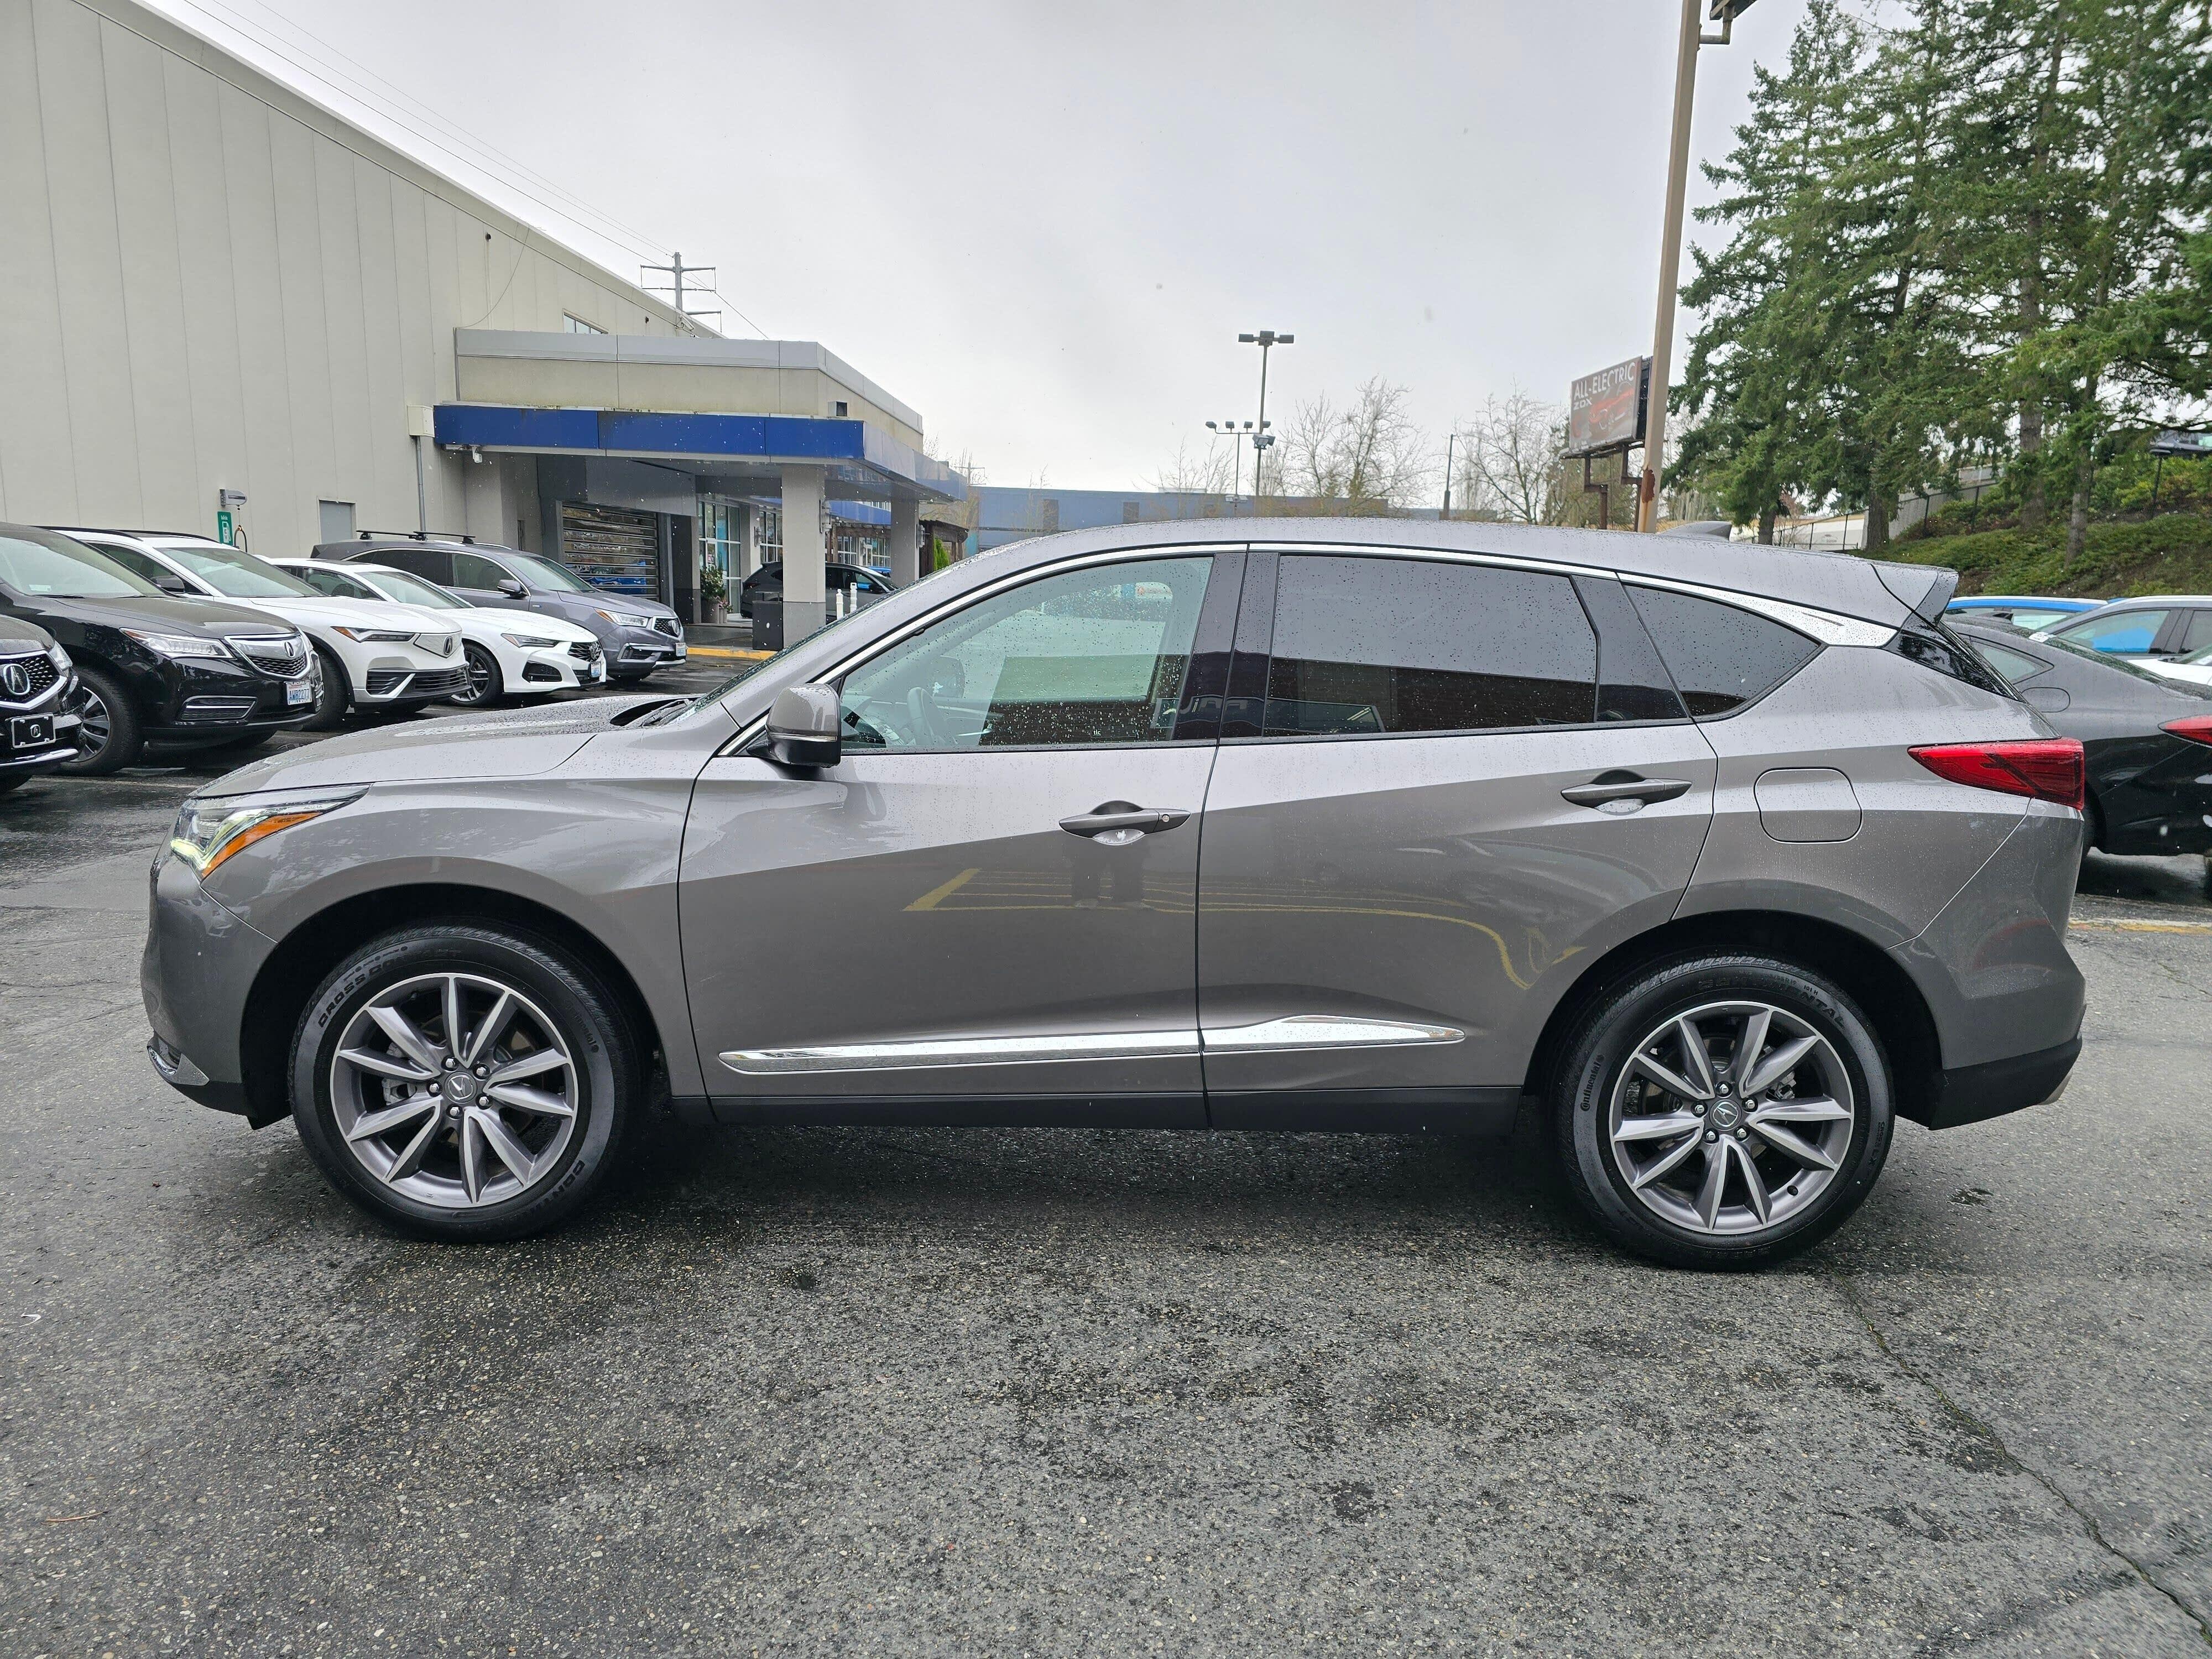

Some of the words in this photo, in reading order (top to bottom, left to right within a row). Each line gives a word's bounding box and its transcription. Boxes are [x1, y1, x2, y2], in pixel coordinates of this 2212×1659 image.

[1574, 362, 1635, 400] ALL-ELECTRIC
[1573, 397, 1593, 410] ZDX
[318, 973, 366, 1027] CROSS
